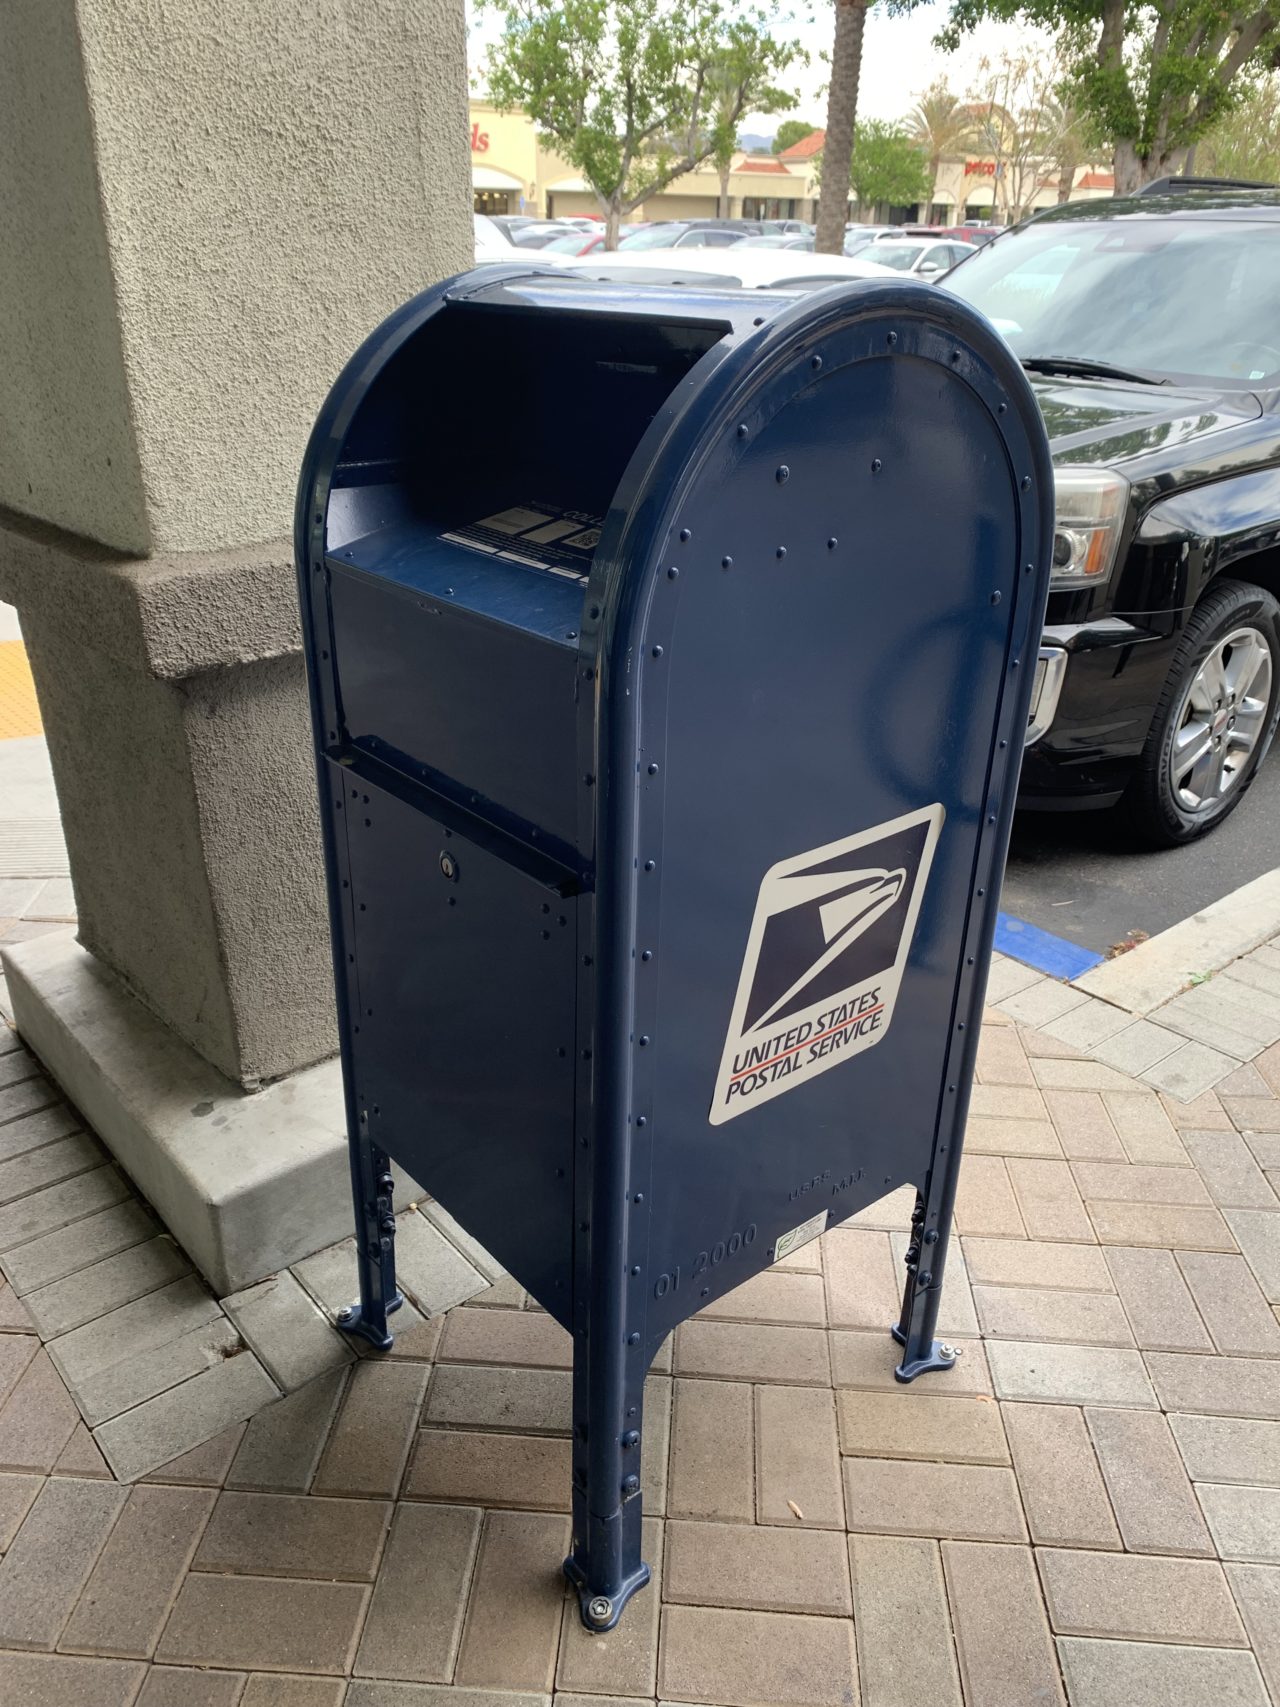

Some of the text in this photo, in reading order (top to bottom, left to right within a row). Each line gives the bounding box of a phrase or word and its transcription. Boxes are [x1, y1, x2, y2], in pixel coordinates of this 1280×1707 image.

[725, 1009, 883, 1105] POSTAL SERVICE
[732, 986, 881, 1075] UNITED STATES
[692, 1223, 757, 1279] 2000
